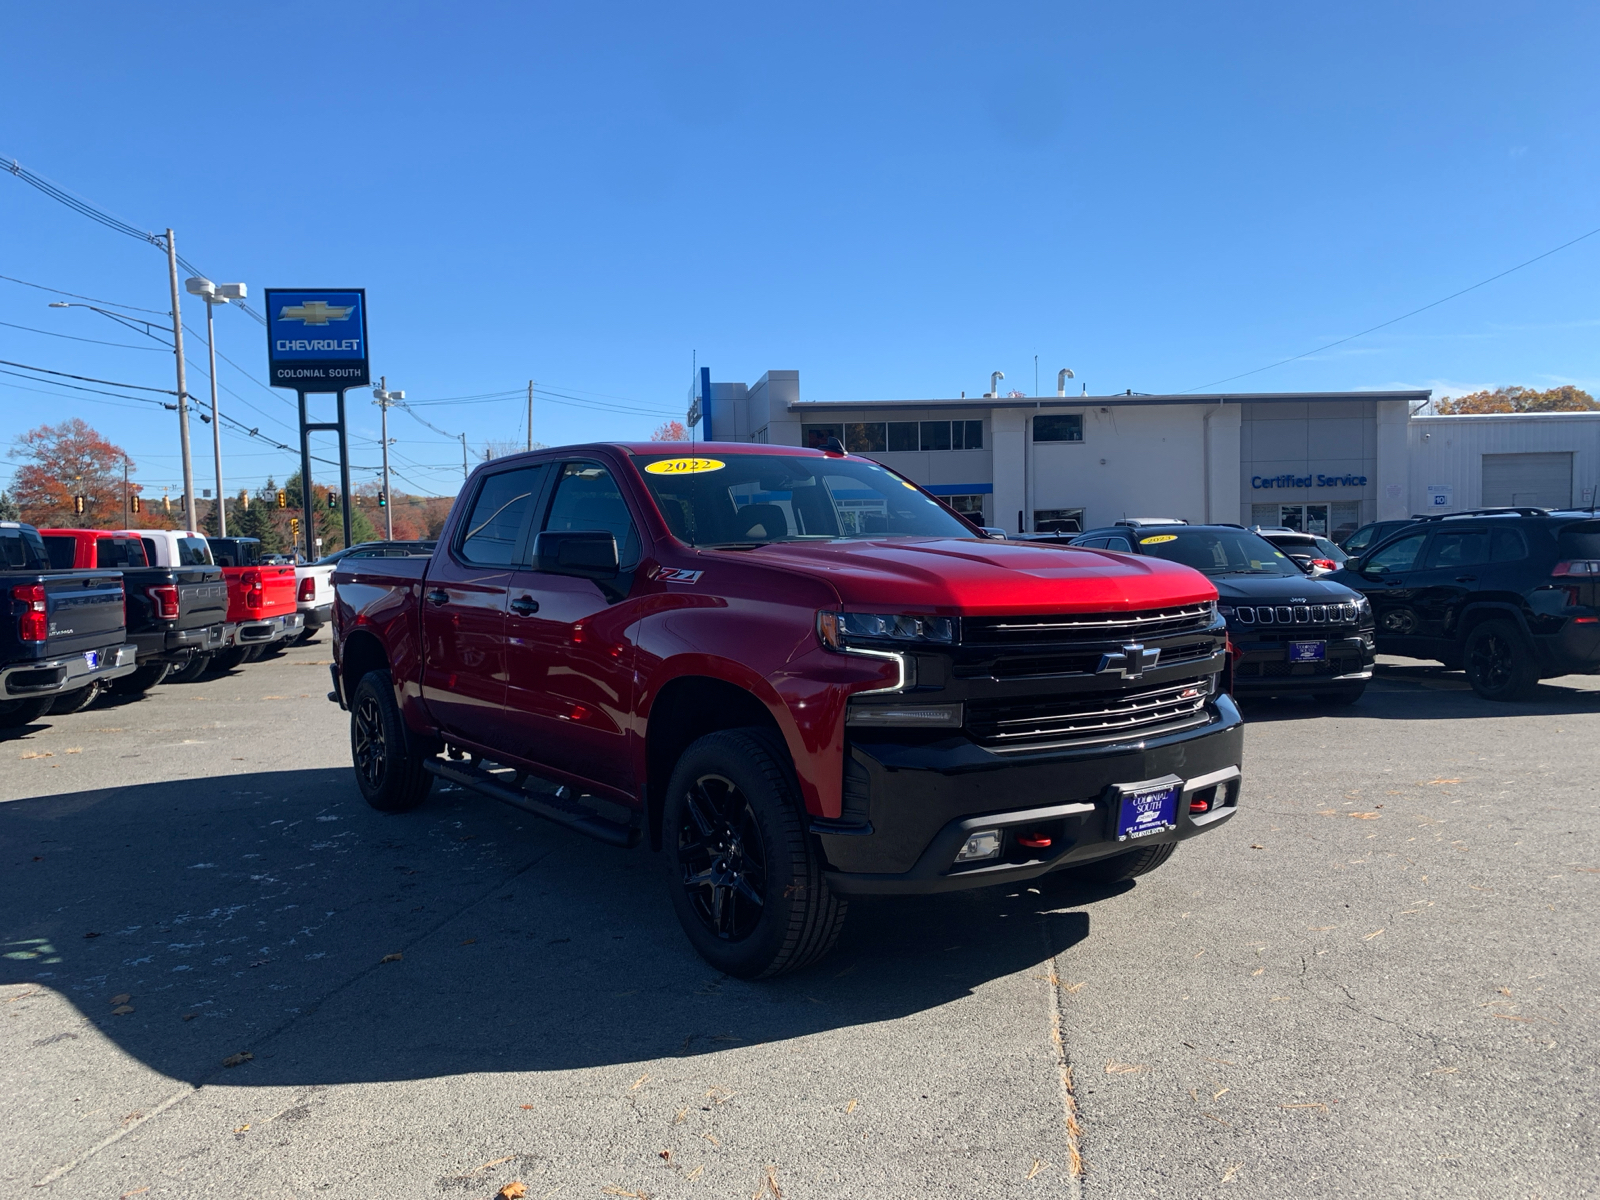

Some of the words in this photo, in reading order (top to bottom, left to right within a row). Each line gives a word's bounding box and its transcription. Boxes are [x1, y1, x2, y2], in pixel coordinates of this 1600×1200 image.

[276, 339, 359, 351] CHEVROLET
[277, 369, 325, 378] COLONIAL
[328, 368, 361, 377] SOUTH
[663, 460, 711, 473] 2022
[1251, 474, 1312, 489] Certified
[1316, 474, 1367, 487] Service
[1132, 791, 1168, 806] COLONIAL
[1136, 800, 1162, 814] SOUTH
